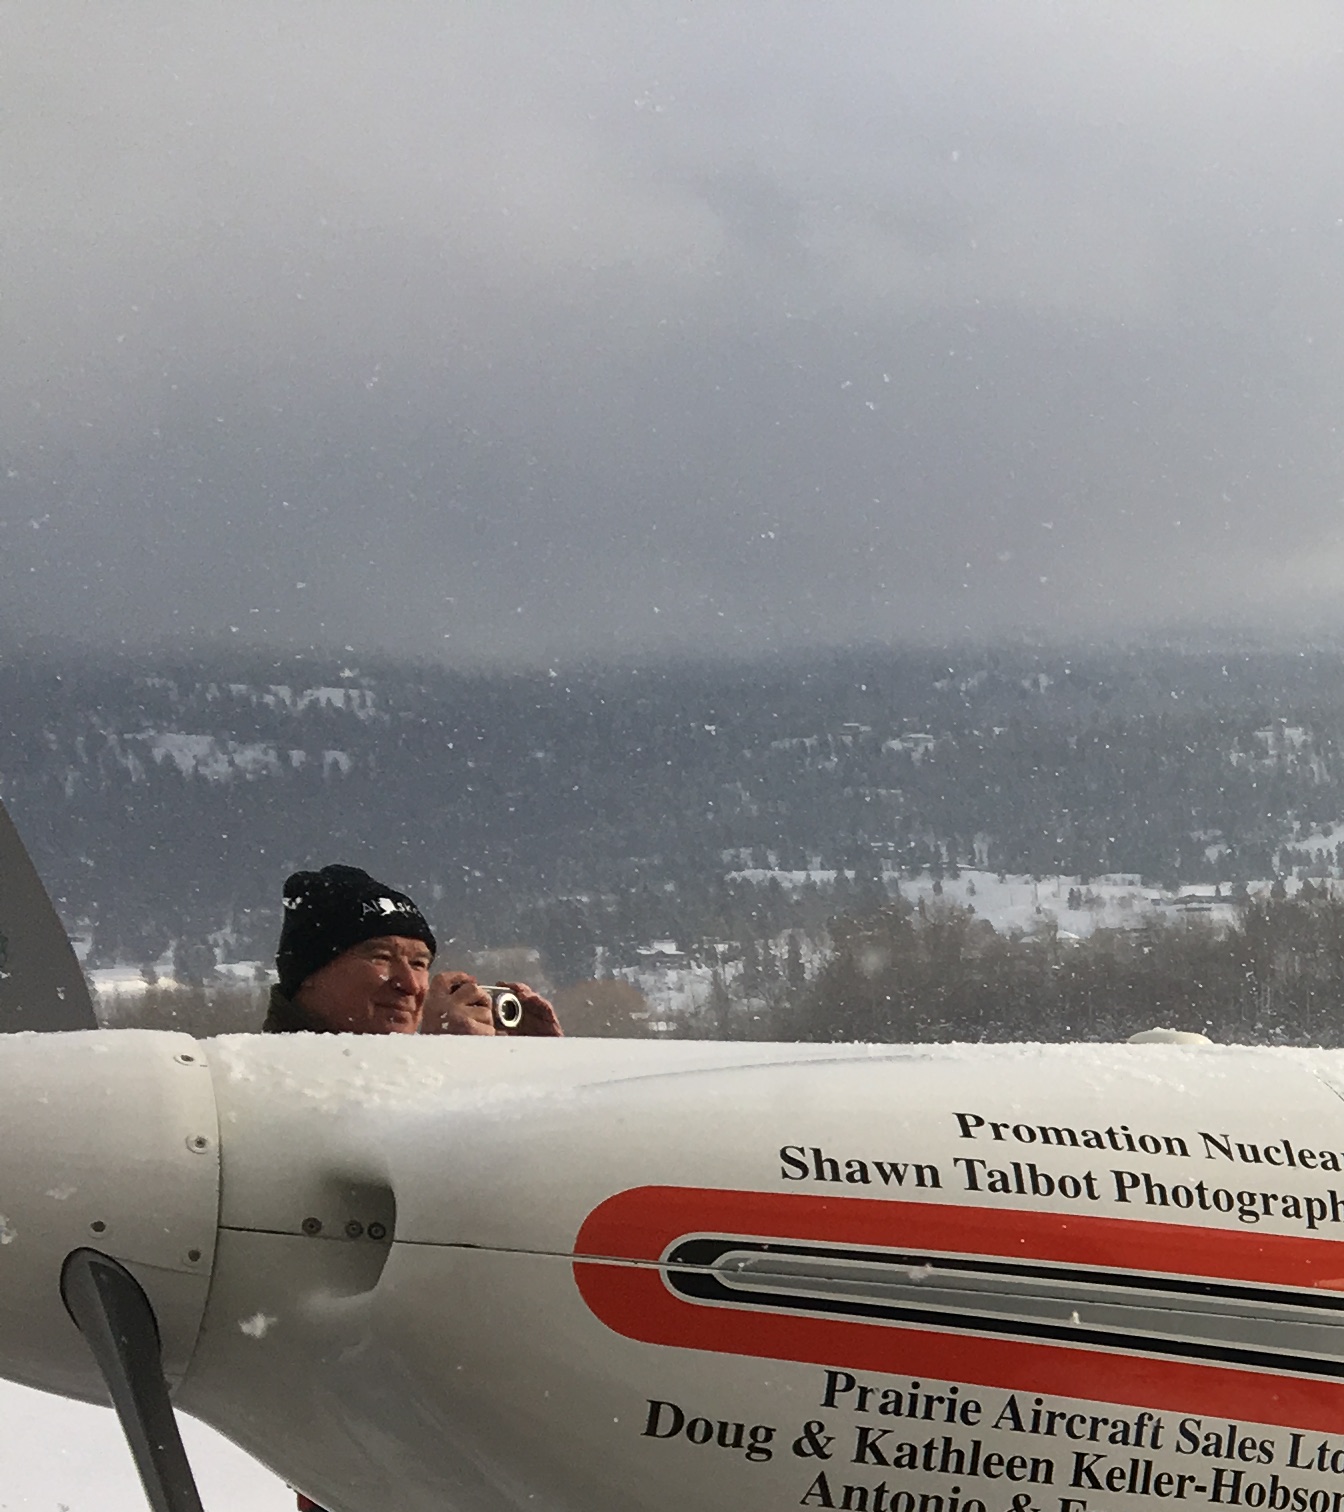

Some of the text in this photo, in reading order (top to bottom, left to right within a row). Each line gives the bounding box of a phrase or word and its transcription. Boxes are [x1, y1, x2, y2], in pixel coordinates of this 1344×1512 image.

[953, 1112, 1190, 1157] Promation
[780, 1144, 941, 1191] Shawn
[953, 1157, 1100, 1203] Talbot
[641, 1399, 776, 1463] Doug
[792, 1421, 836, 1459] &
[852, 1426, 1056, 1486] Kathleen
[820, 1369, 982, 1425] Prairie
[992, 1396, 1166, 1453] Aircraft
[1175, 1419, 1274, 1467] Sales
